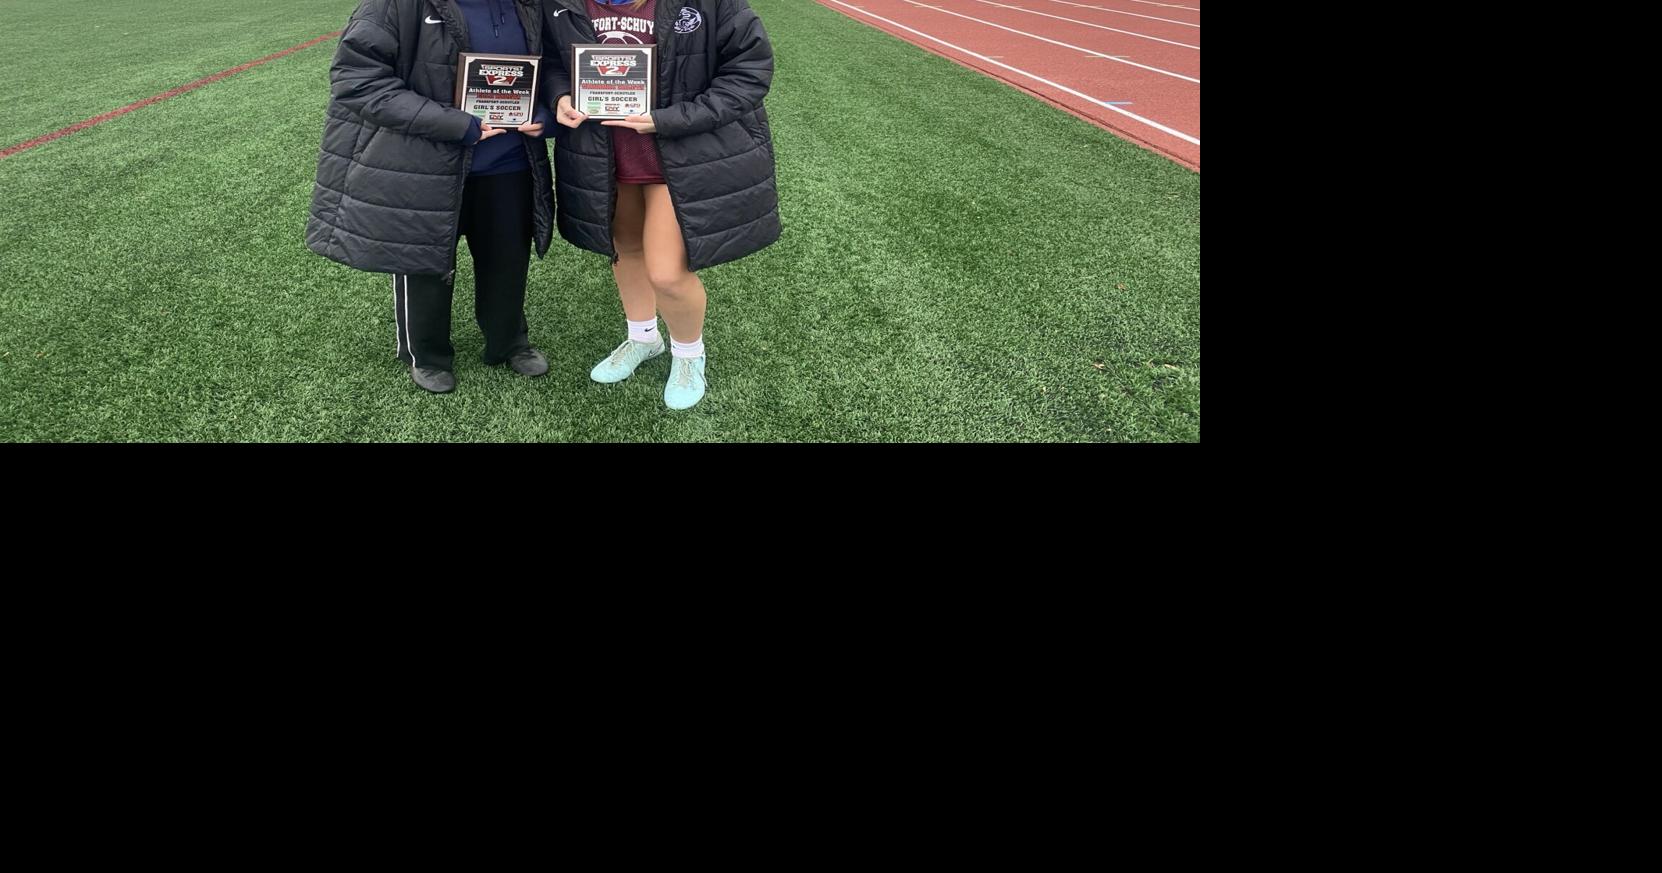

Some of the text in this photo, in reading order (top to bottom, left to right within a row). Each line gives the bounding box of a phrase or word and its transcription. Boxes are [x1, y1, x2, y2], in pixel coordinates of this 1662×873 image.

[479, 69, 524, 77] EXPRESS
[605, 66, 623, 75] 2
[492, 75, 509, 85] 2
